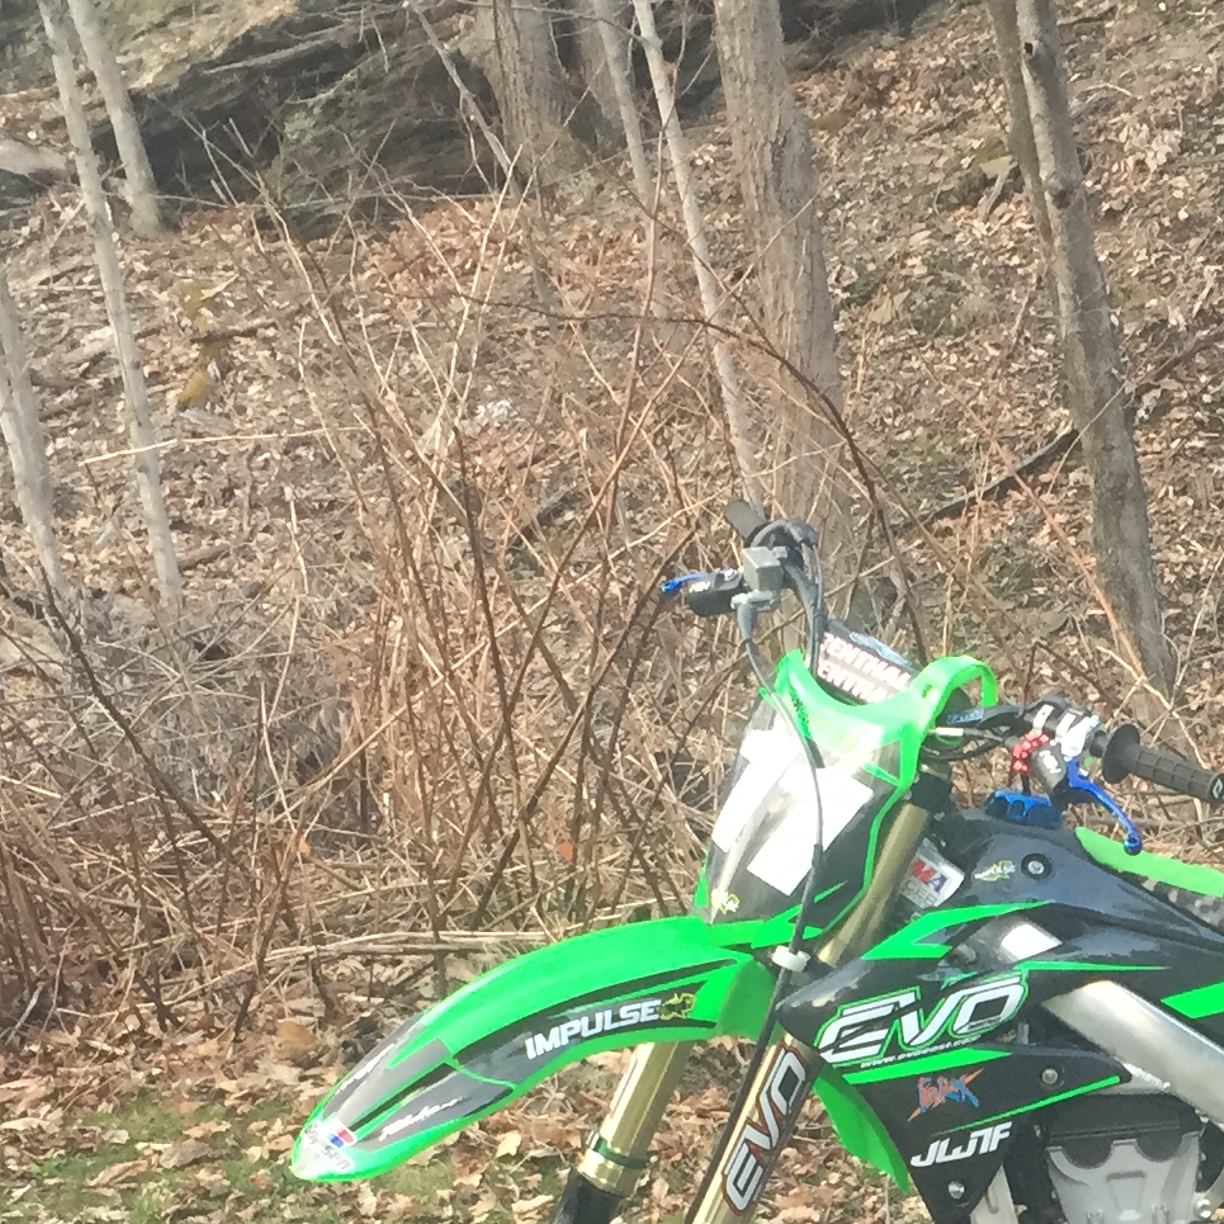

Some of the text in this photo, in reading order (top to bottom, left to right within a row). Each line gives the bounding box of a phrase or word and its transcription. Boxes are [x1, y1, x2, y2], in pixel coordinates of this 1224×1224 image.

[525, 1000, 662, 1060] IMPULSE
[818, 975, 1024, 1064] EVO
[724, 1048, 806, 1211] EVO
